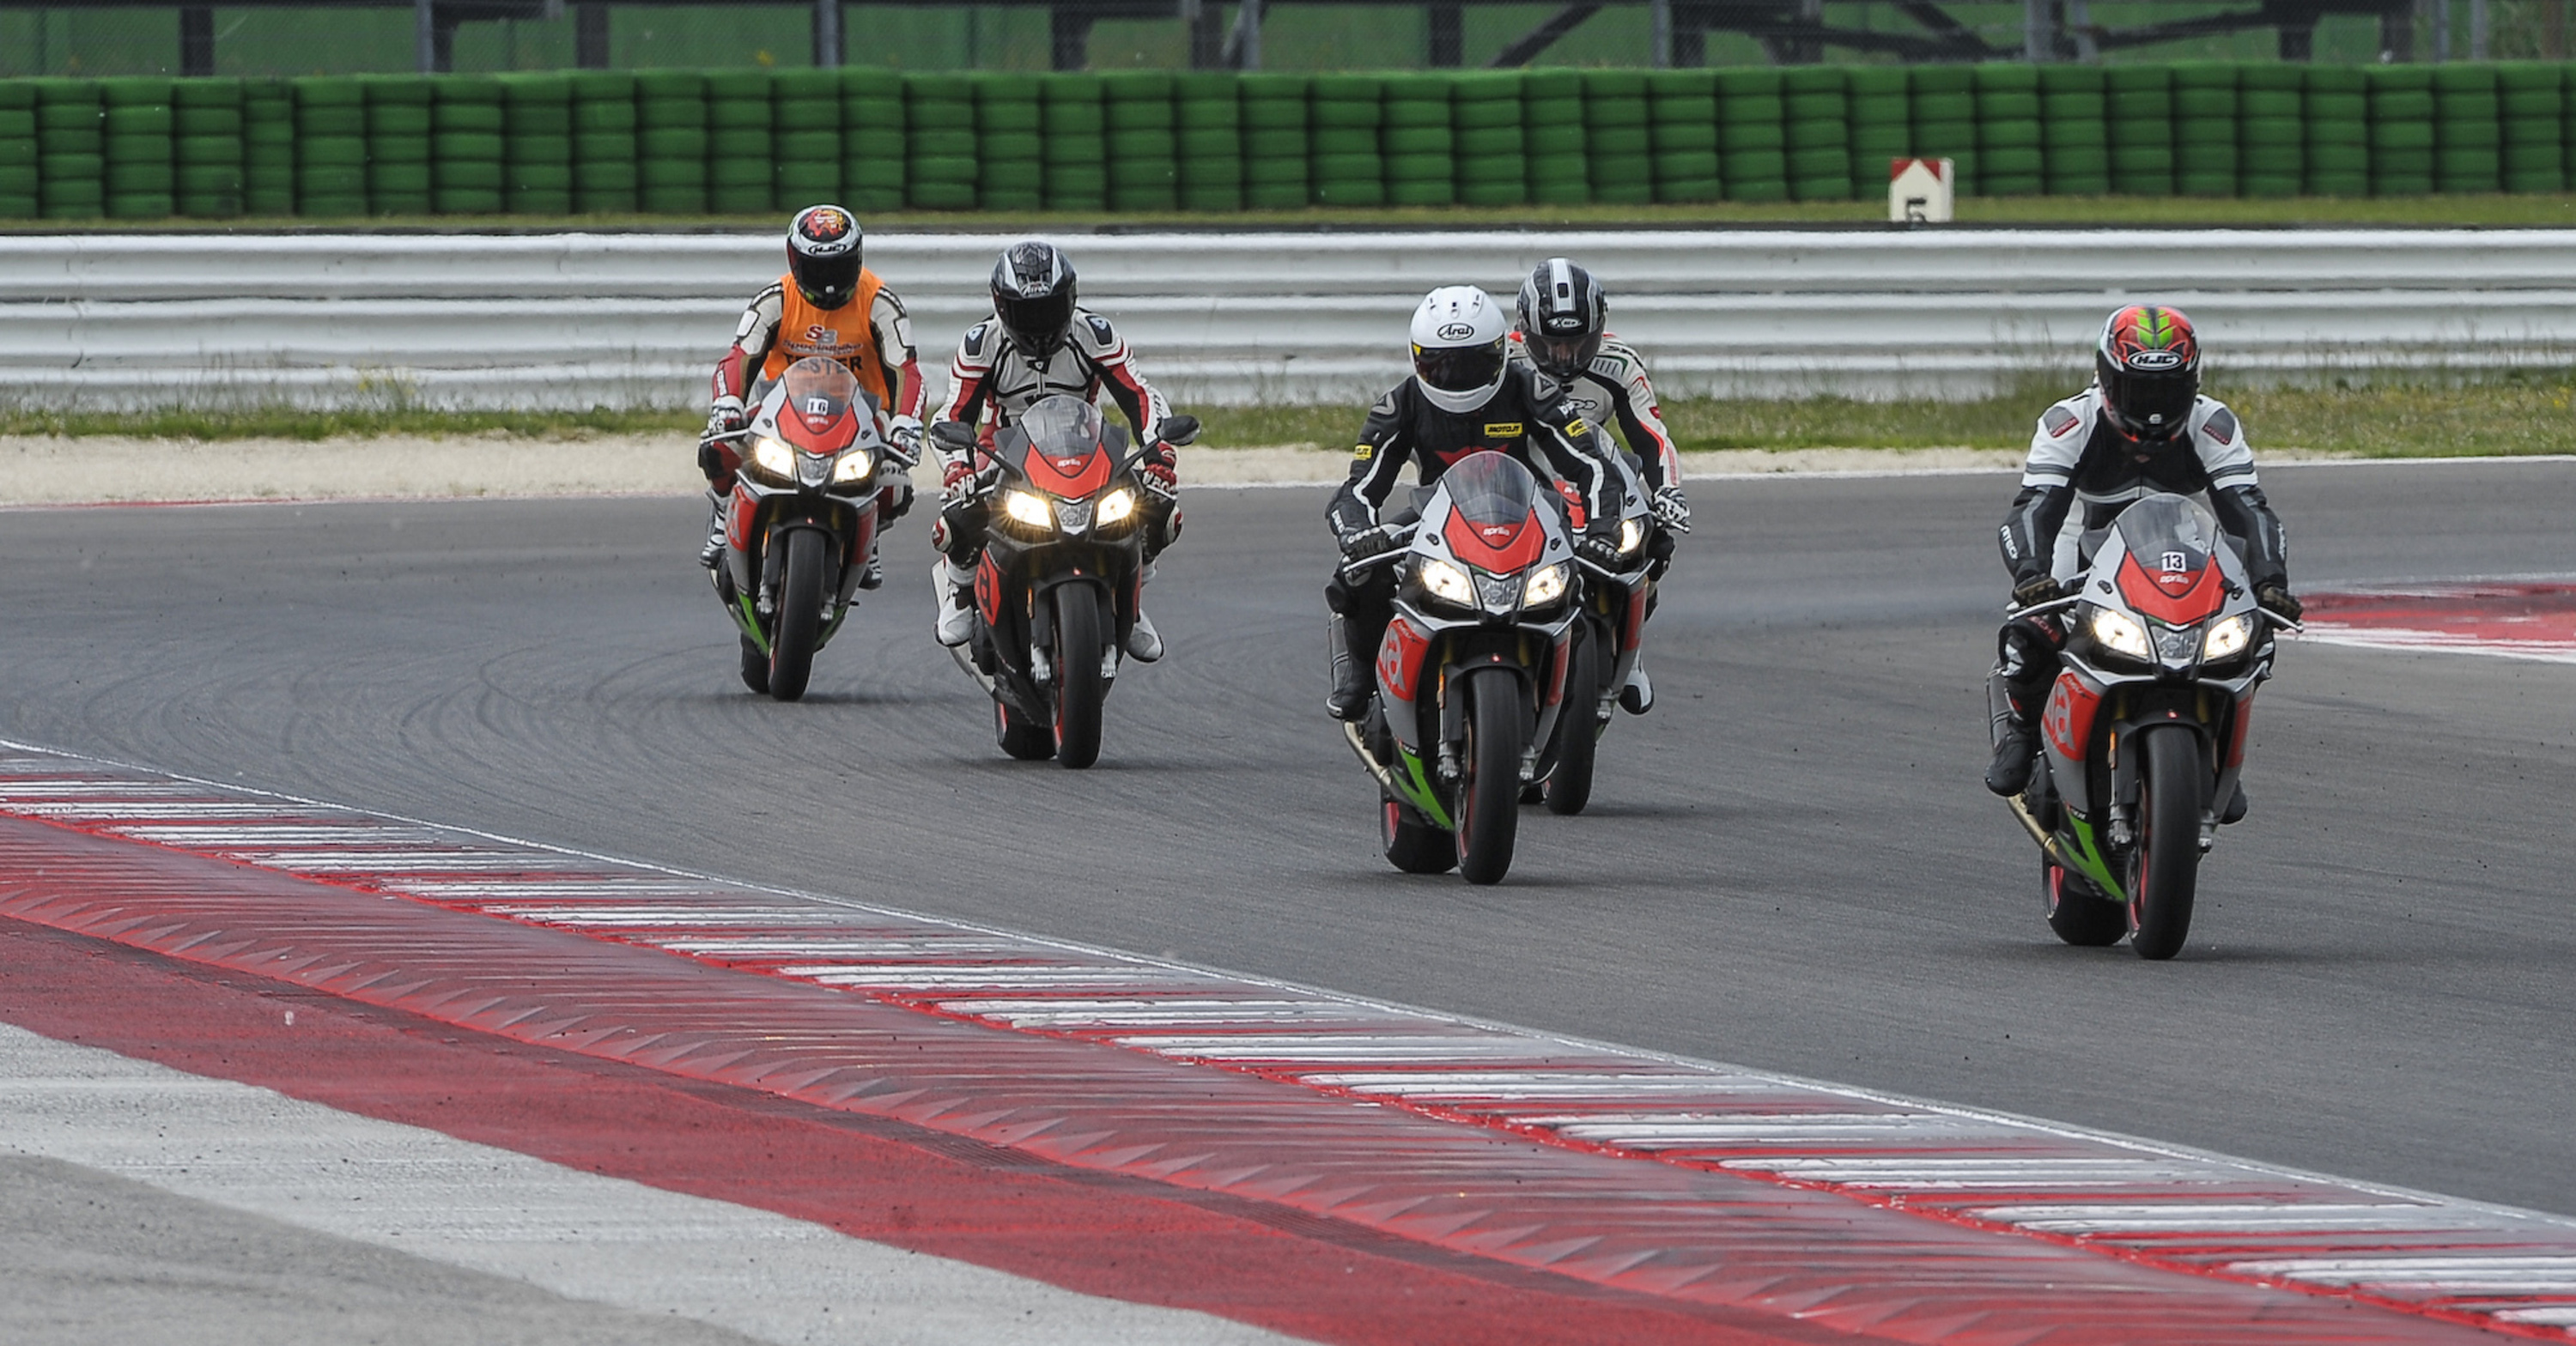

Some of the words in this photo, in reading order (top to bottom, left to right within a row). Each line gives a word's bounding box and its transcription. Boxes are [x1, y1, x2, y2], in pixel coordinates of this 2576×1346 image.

[805, 324, 838, 345] SB
[1440, 324, 1471, 339] Arai
[2137, 355, 2173, 364] HJC
[810, 401, 827, 414] 16
[2165, 554, 2184, 569] 13
